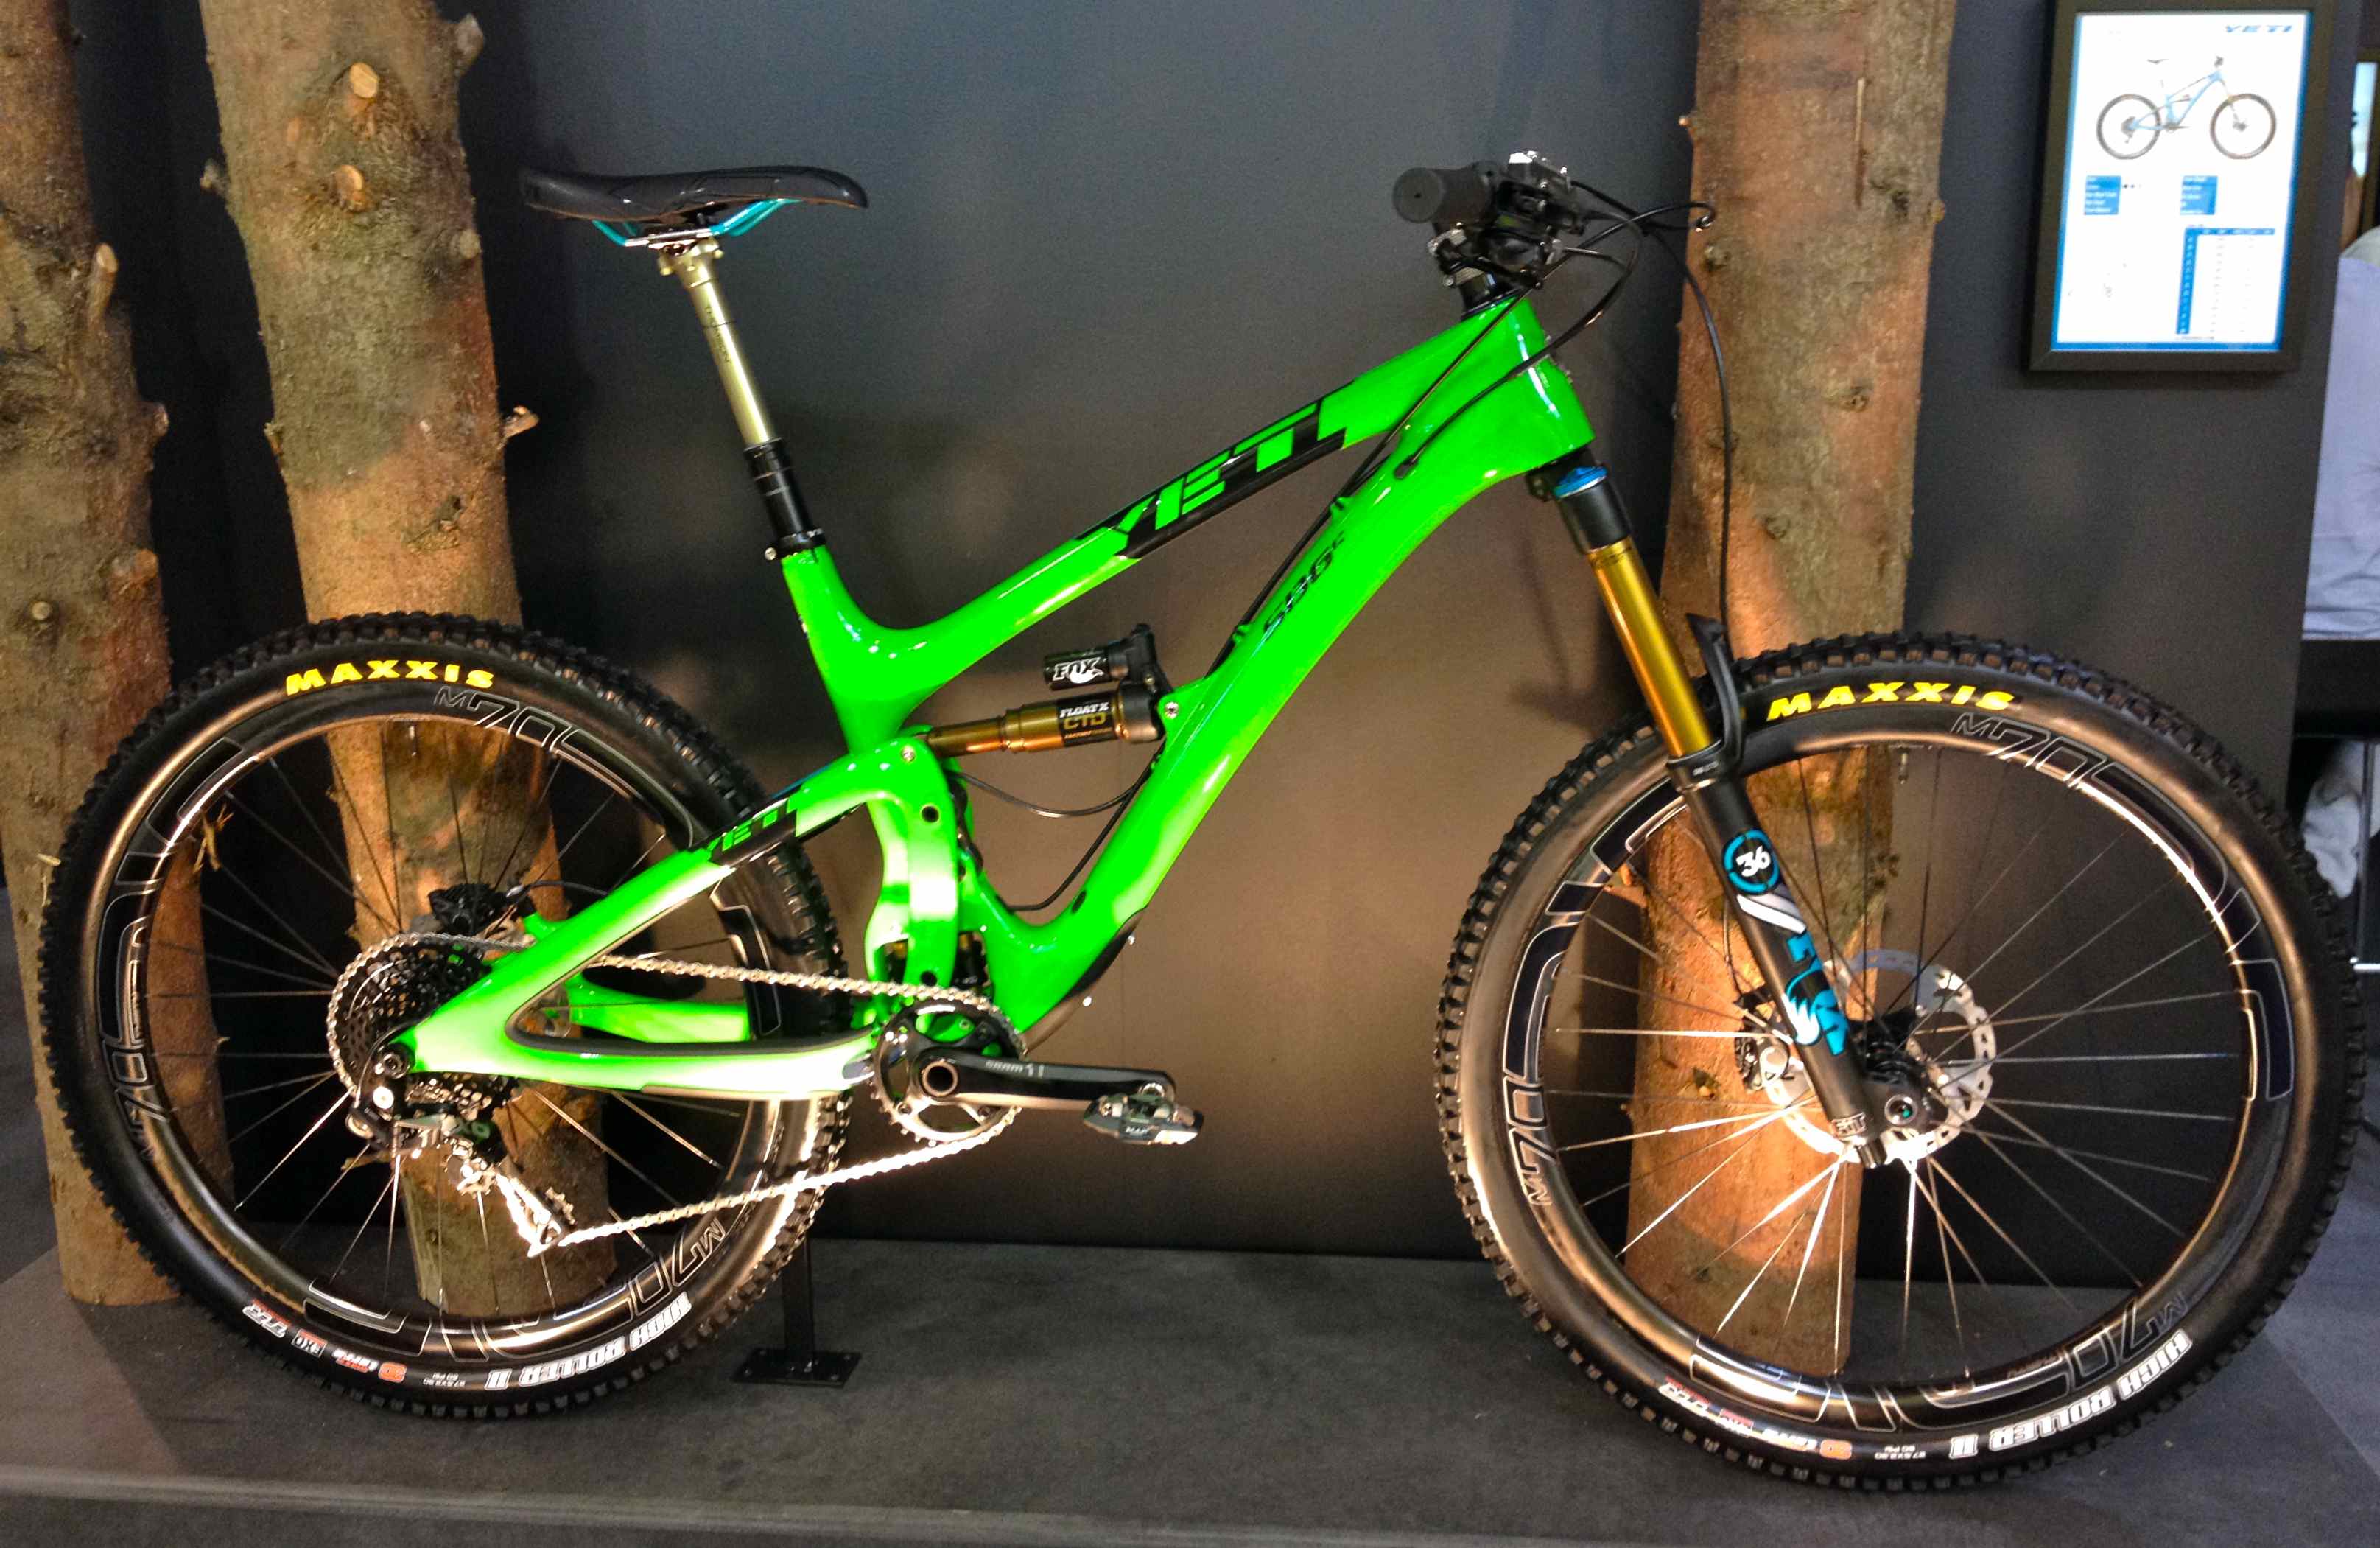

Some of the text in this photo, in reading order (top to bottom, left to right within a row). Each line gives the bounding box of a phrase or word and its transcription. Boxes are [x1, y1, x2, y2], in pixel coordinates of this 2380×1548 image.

[2225, 24, 2293, 34] YETI
[1105, 398, 1347, 558] YETI
[285, 659, 495, 696] MAXXIS
[1053, 656, 1105, 684] FOX
[1766, 680, 2015, 722] MAXXIS
[1064, 712, 1107, 730] CTD
[1736, 846, 1772, 877] 36
[484, 1291, 692, 1390] HIGH ROLLER II
[2117, 1328, 2192, 1400] HIGH
[1988, 1387, 2117, 1451] ROLLER
[1948, 1434, 1979, 1459] II
